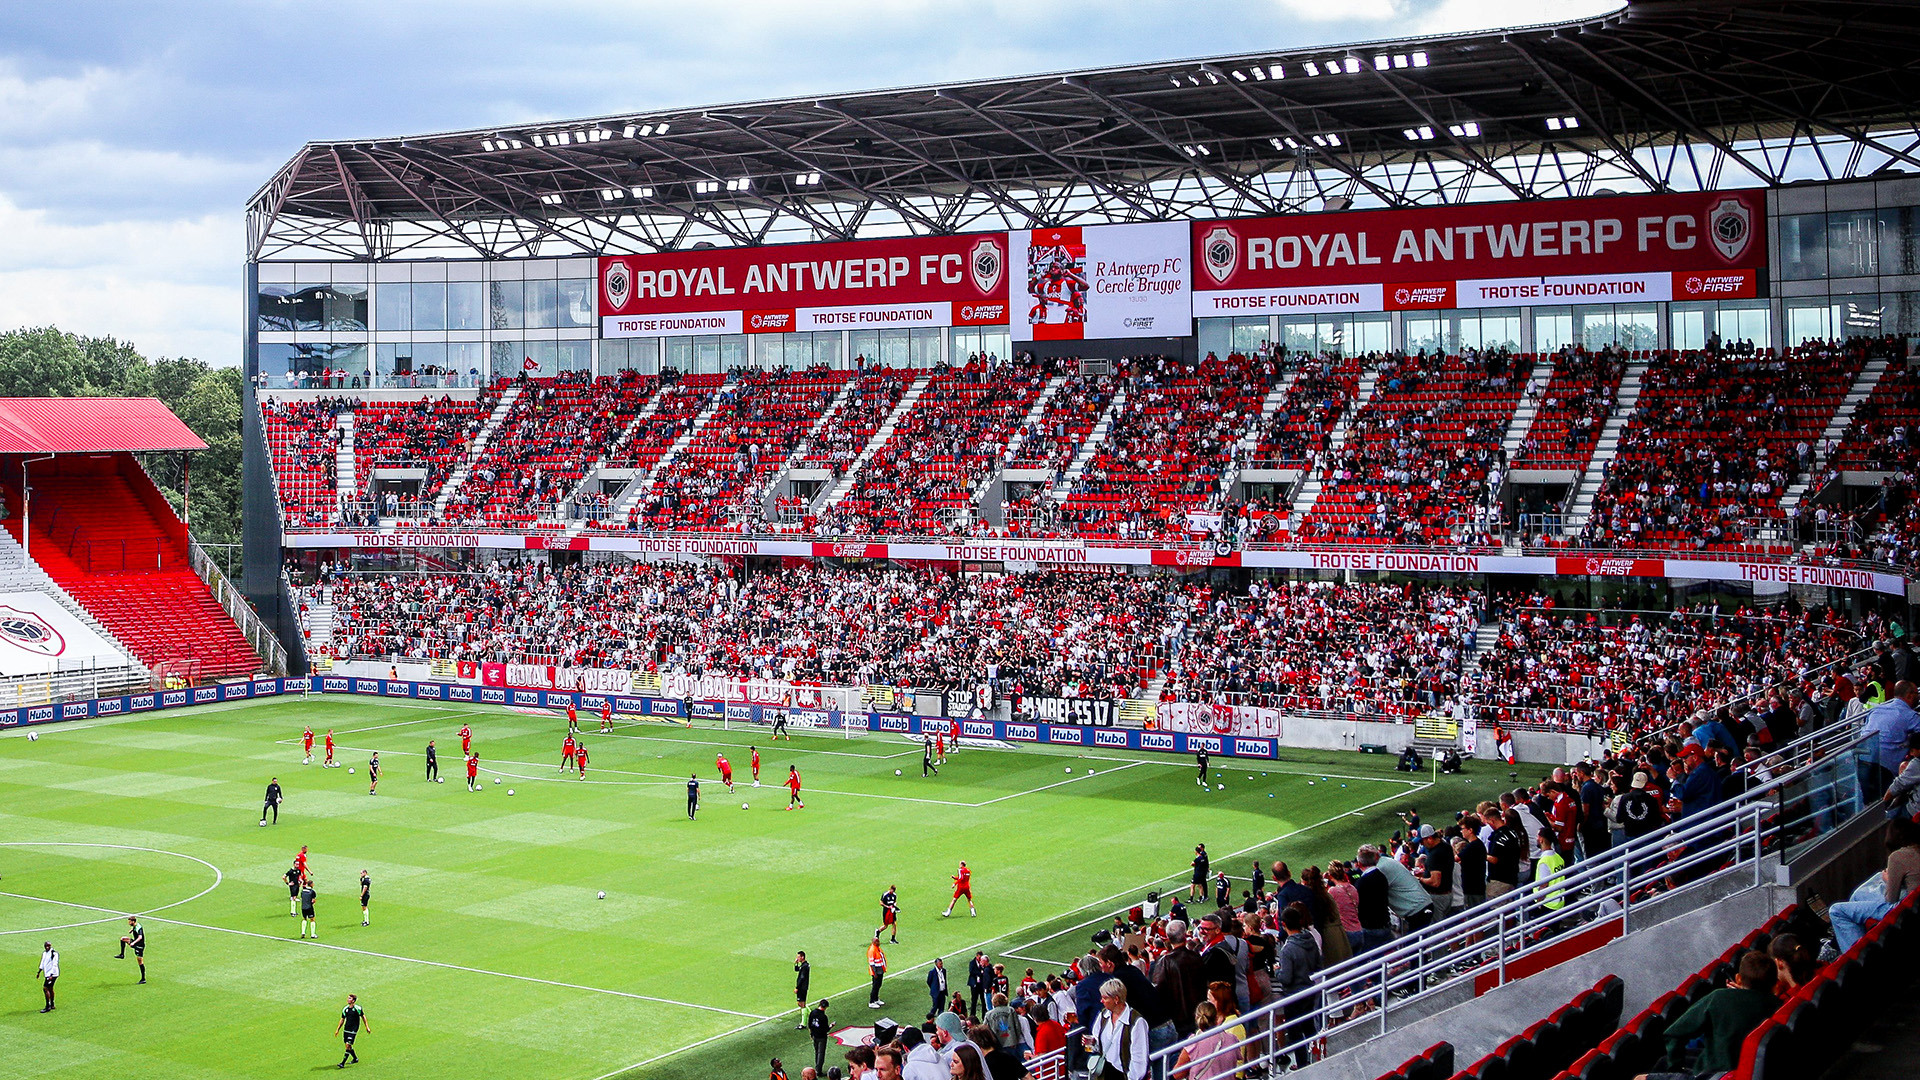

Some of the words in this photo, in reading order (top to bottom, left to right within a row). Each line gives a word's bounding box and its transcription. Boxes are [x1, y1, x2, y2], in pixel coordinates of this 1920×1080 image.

[1247, 231, 1381, 270] ROYAL
[1392, 218, 1622, 264] ANTWERP
[1637, 214, 1696, 252] FC
[1096, 262, 1105, 277] R
[1108, 260, 1160, 278] Antwerp
[1163, 258, 1182, 273] FC
[637, 266, 735, 299] ROYAL
[743, 256, 910, 294] ANTWERP
[920, 253, 963, 286] FC
[1705, 275, 1744, 285] ANTWERP
[1096, 277, 1135, 294] Cercle
[1138, 277, 1181, 295] Brugge
[1412, 287, 1446, 295] ANTWERP
[1479, 284, 1540, 299] TROTSE
[1543, 281, 1645, 297] FOUNDATION
[1702, 283, 1743, 292] FIRST
[1213, 296, 1266, 309] TROTSE
[1270, 292, 1360, 306] FOUNDATION
[1410, 294, 1445, 303] FIRST
[812, 312, 856, 324] TROTSE
[859, 309, 933, 322] FOUNDATION
[973, 311, 1003, 319] FIRST
[617, 320, 657, 331] TROTSE
[659, 318, 726, 330] FOUNDATION
[762, 319, 788, 327] FIRST
[354, 535, 404, 546] TROTSE
[407, 535, 479, 547] FOUNDATION
[639, 539, 682, 552] TROTSE
[685, 540, 758, 554] FOUNDATION
[842, 549, 866, 557] FIRST
[945, 546, 997, 560] TROTSE
[1001, 547, 1086, 562] FOUNDATION
[1187, 557, 1215, 566] FIRST
[1310, 553, 1371, 569] TROTSE
[1376, 555, 1478, 572] FOUNDATION
[1601, 559, 1634, 567] ANTWERP
[1600, 566, 1633, 576] FIRST
[1739, 563, 1798, 583] TROTSE
[1801, 566, 1875, 590] FOUNDATION
[506, 664, 553, 689] ROYAL
[255, 682, 275, 693] Hubo
[325, 680, 348, 690] Hubo
[357, 682, 378, 692] Hubo
[388, 684, 408, 694] Hubo
[419, 685, 440, 696] Hubo
[195, 690, 216, 700] Hubo
[226, 686, 246, 696] Hubo
[450, 688, 472, 698] Hubo
[482, 690, 504, 701] Hubo
[947, 690, 973, 703] STOP
[132, 698, 153, 708] Hubo
[164, 693, 185, 704] Hubo
[515, 692, 537, 703] Hubo
[548, 694, 570, 705] Hubo
[64, 705, 87, 715] Hubo
[98, 701, 120, 712] Hubo
[617, 701, 640, 711] Hubo
[652, 704, 676, 713] Hubo
[0, 714, 17, 722] ubo
[29, 709, 52, 720] Hubo
[1093, 701, 1109, 726] 17
[788, 714, 818, 727] FIRST
[922, 721, 950, 733] Hubo
[964, 723, 992, 735] Hubo
[1007, 726, 1036, 738] Hubo
[1051, 729, 1080, 741] Hubo
[1096, 732, 1126, 745] Hubo
[1142, 735, 1173, 748] Hubo
[1237, 741, 1269, 754] Hubo
